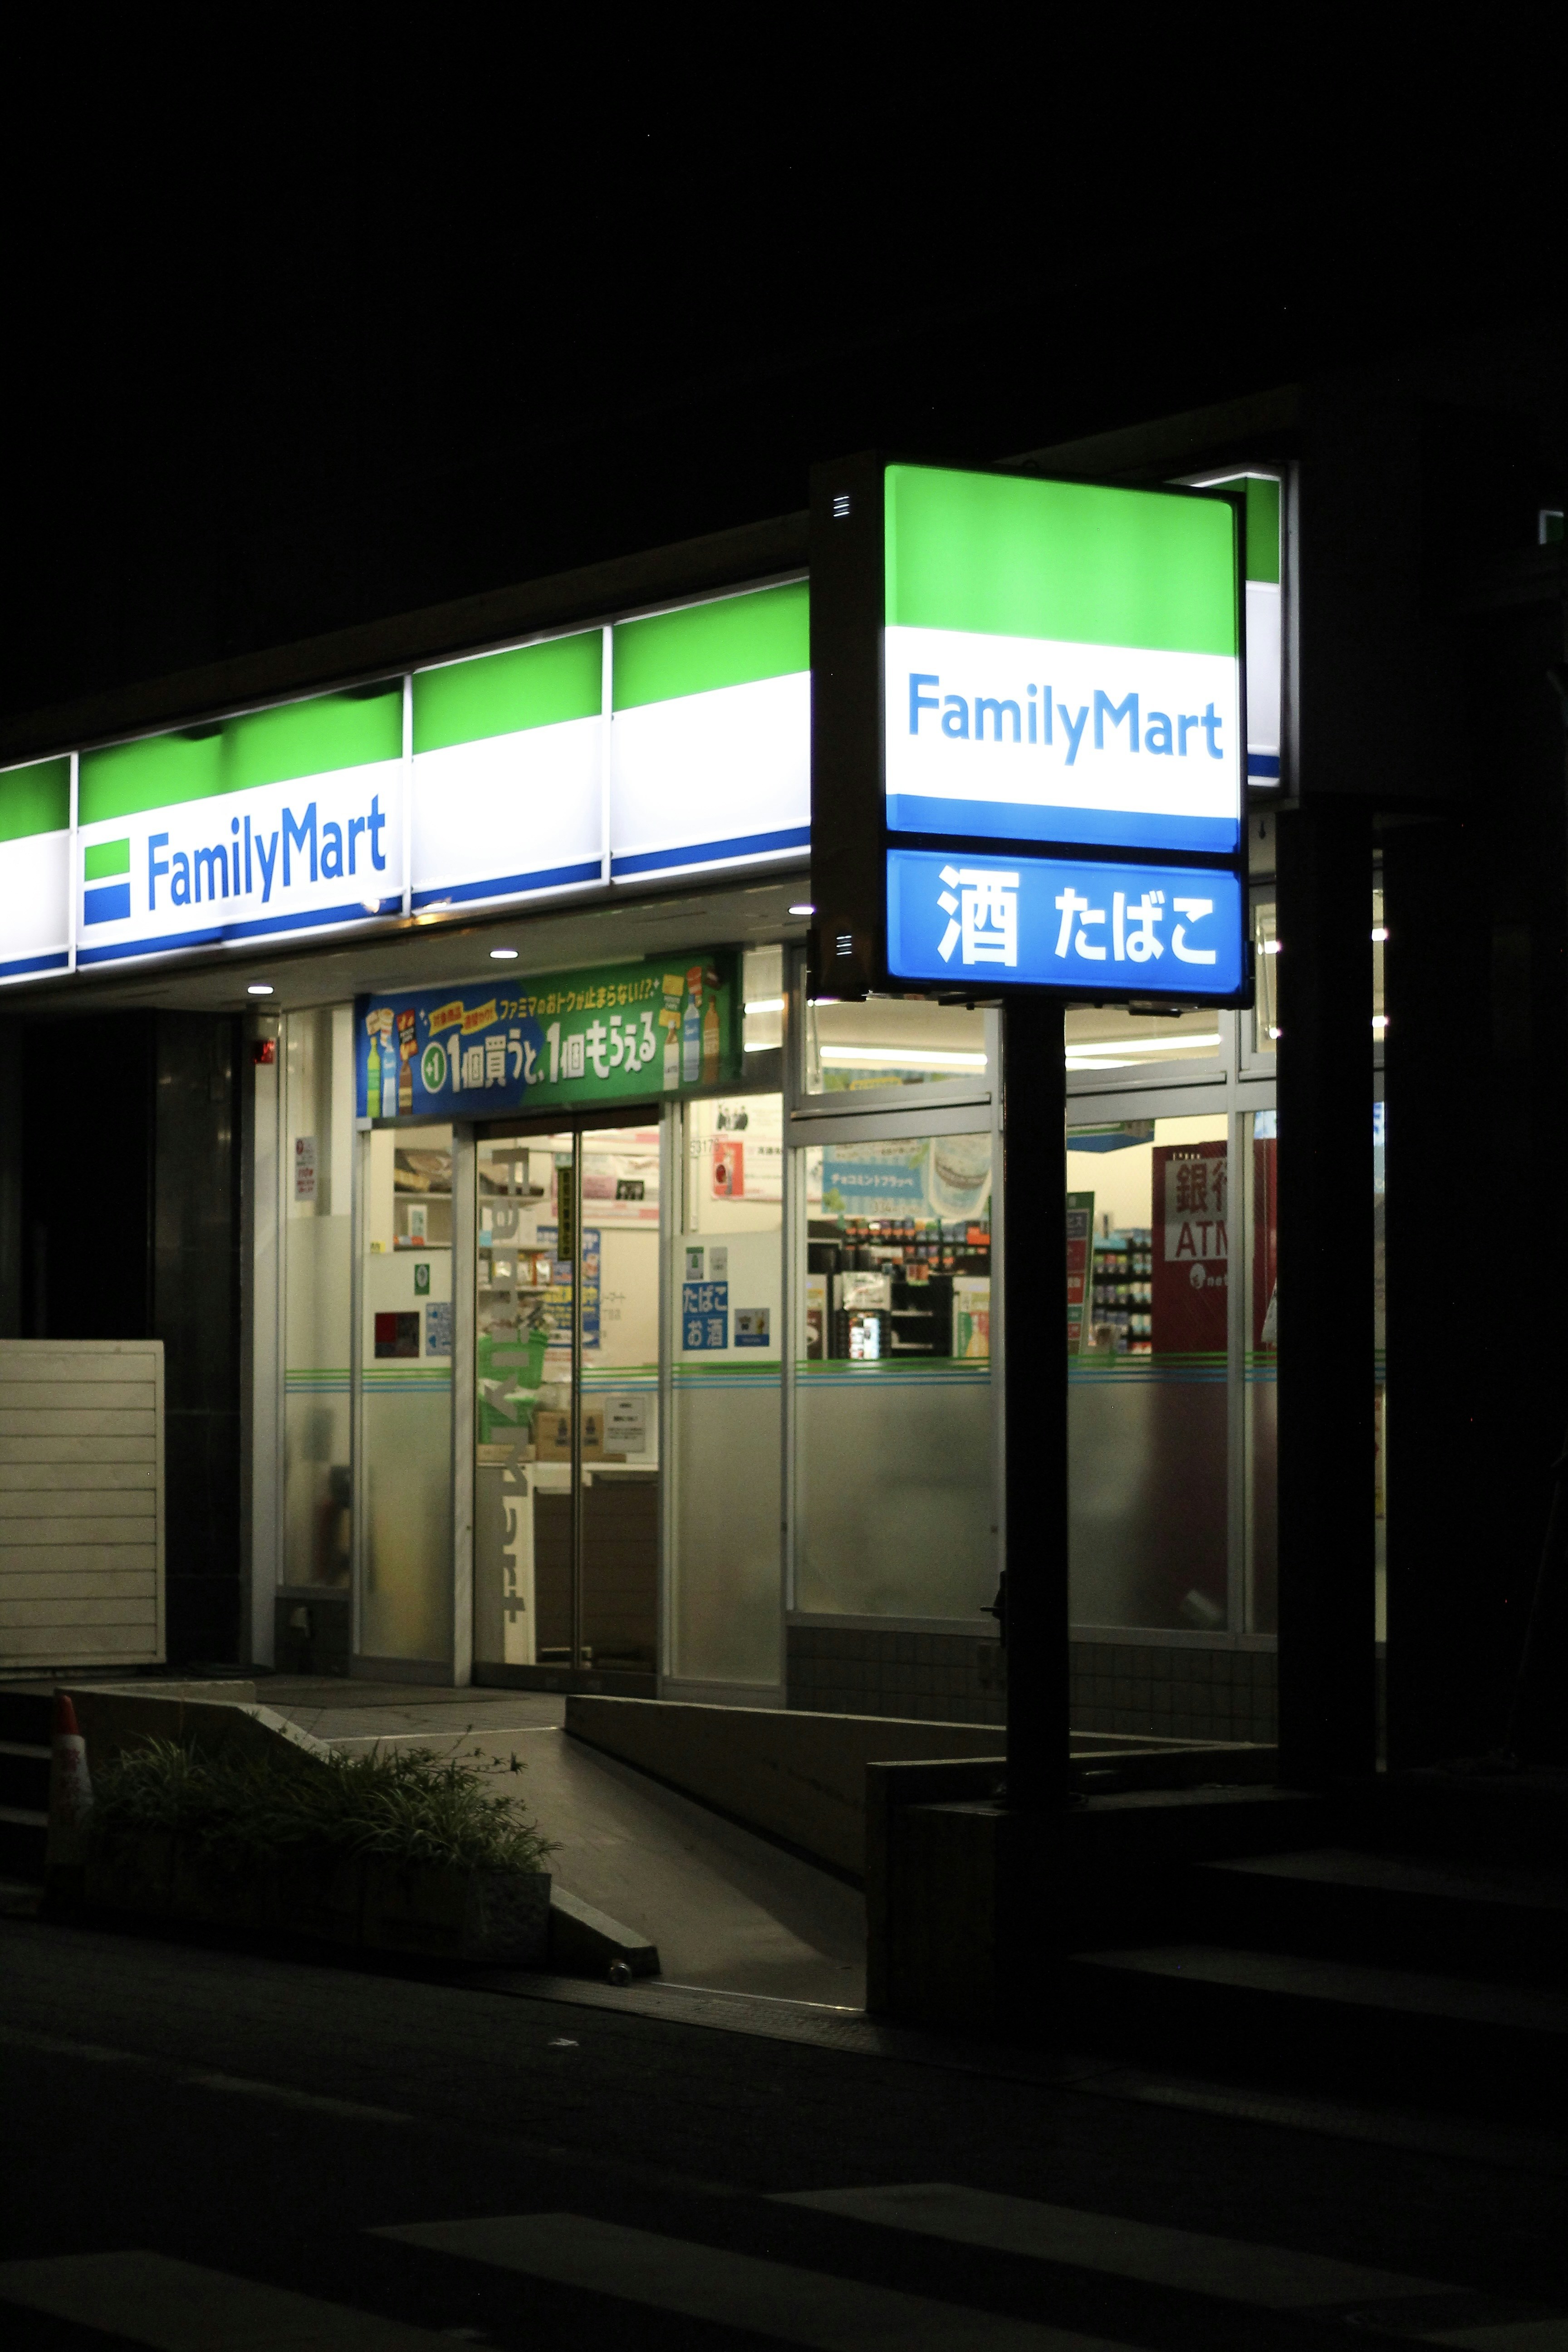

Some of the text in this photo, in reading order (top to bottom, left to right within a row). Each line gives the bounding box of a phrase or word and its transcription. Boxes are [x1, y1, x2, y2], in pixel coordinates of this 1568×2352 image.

[909, 673, 1224, 766] FamilyMart
[148, 794, 386, 911] FamilyMart
[936, 865, 1217, 967] 酒 たばこ
[683, 1284, 727, 1313] たばこ
[687, 1318, 723, 1347] お酒
[484, 1147, 529, 1623] FamilyMart
